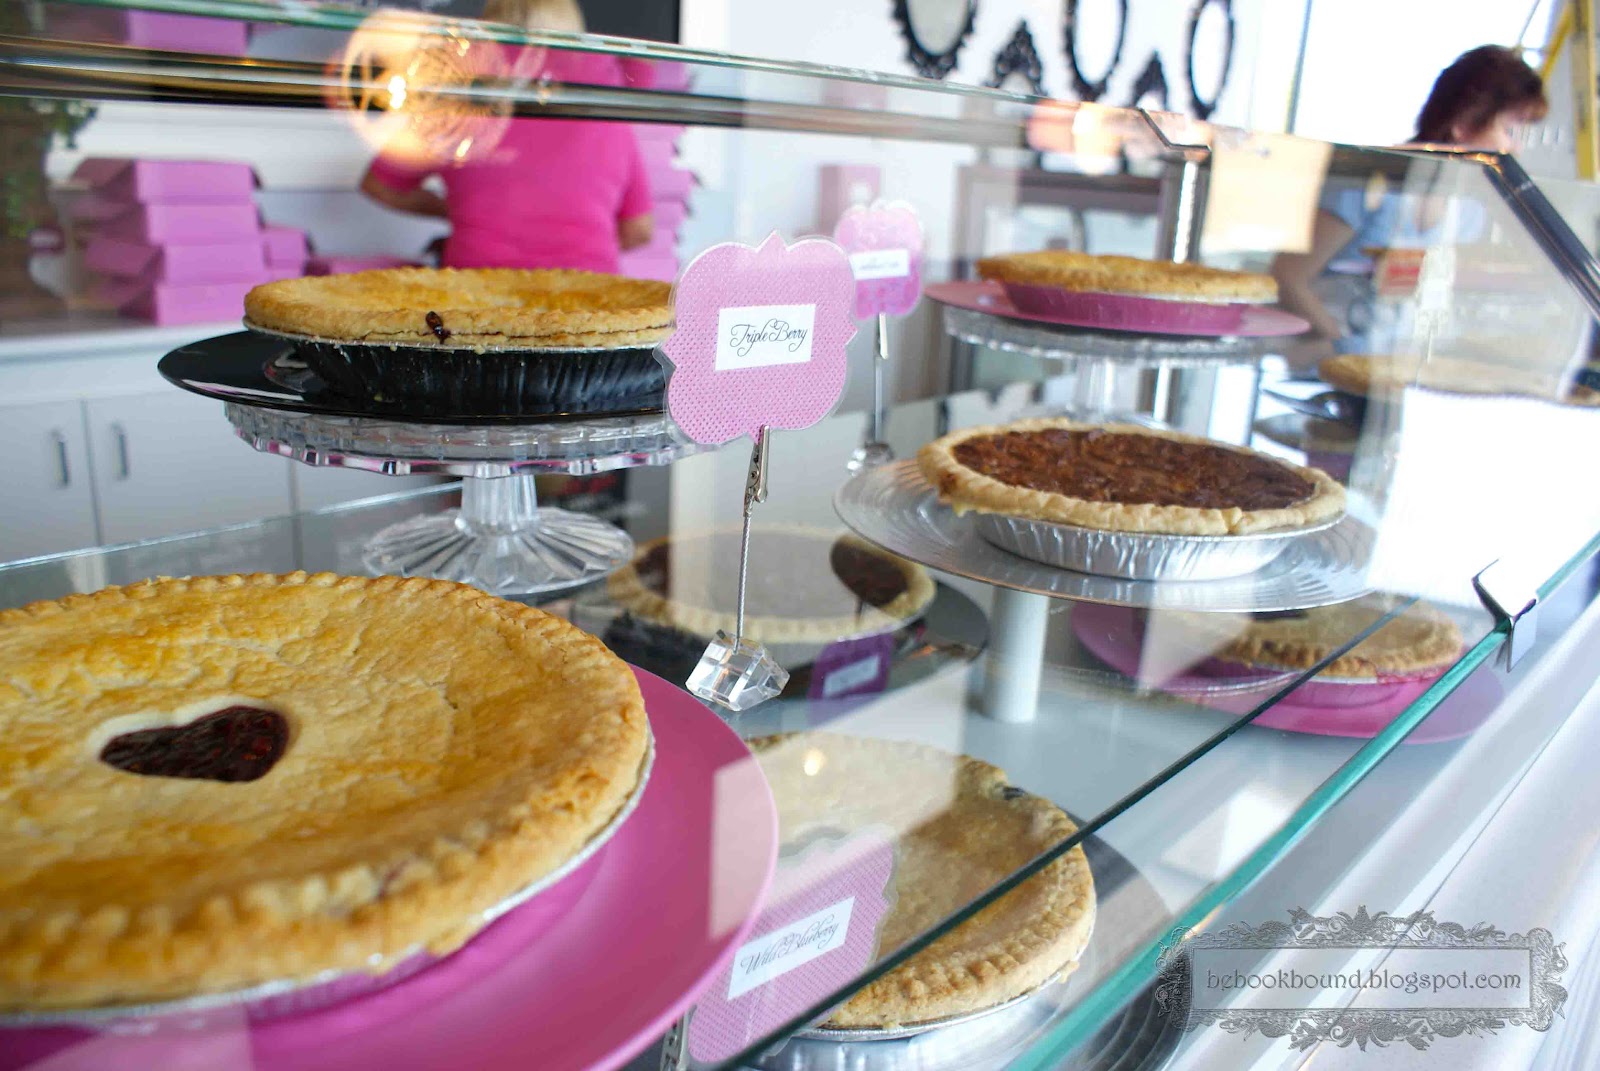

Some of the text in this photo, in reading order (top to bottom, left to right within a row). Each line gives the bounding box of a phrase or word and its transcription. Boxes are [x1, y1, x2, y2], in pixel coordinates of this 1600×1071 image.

[729, 319, 809, 357] Triple Berry
[740, 914, 840, 975] Wild Blueberry
